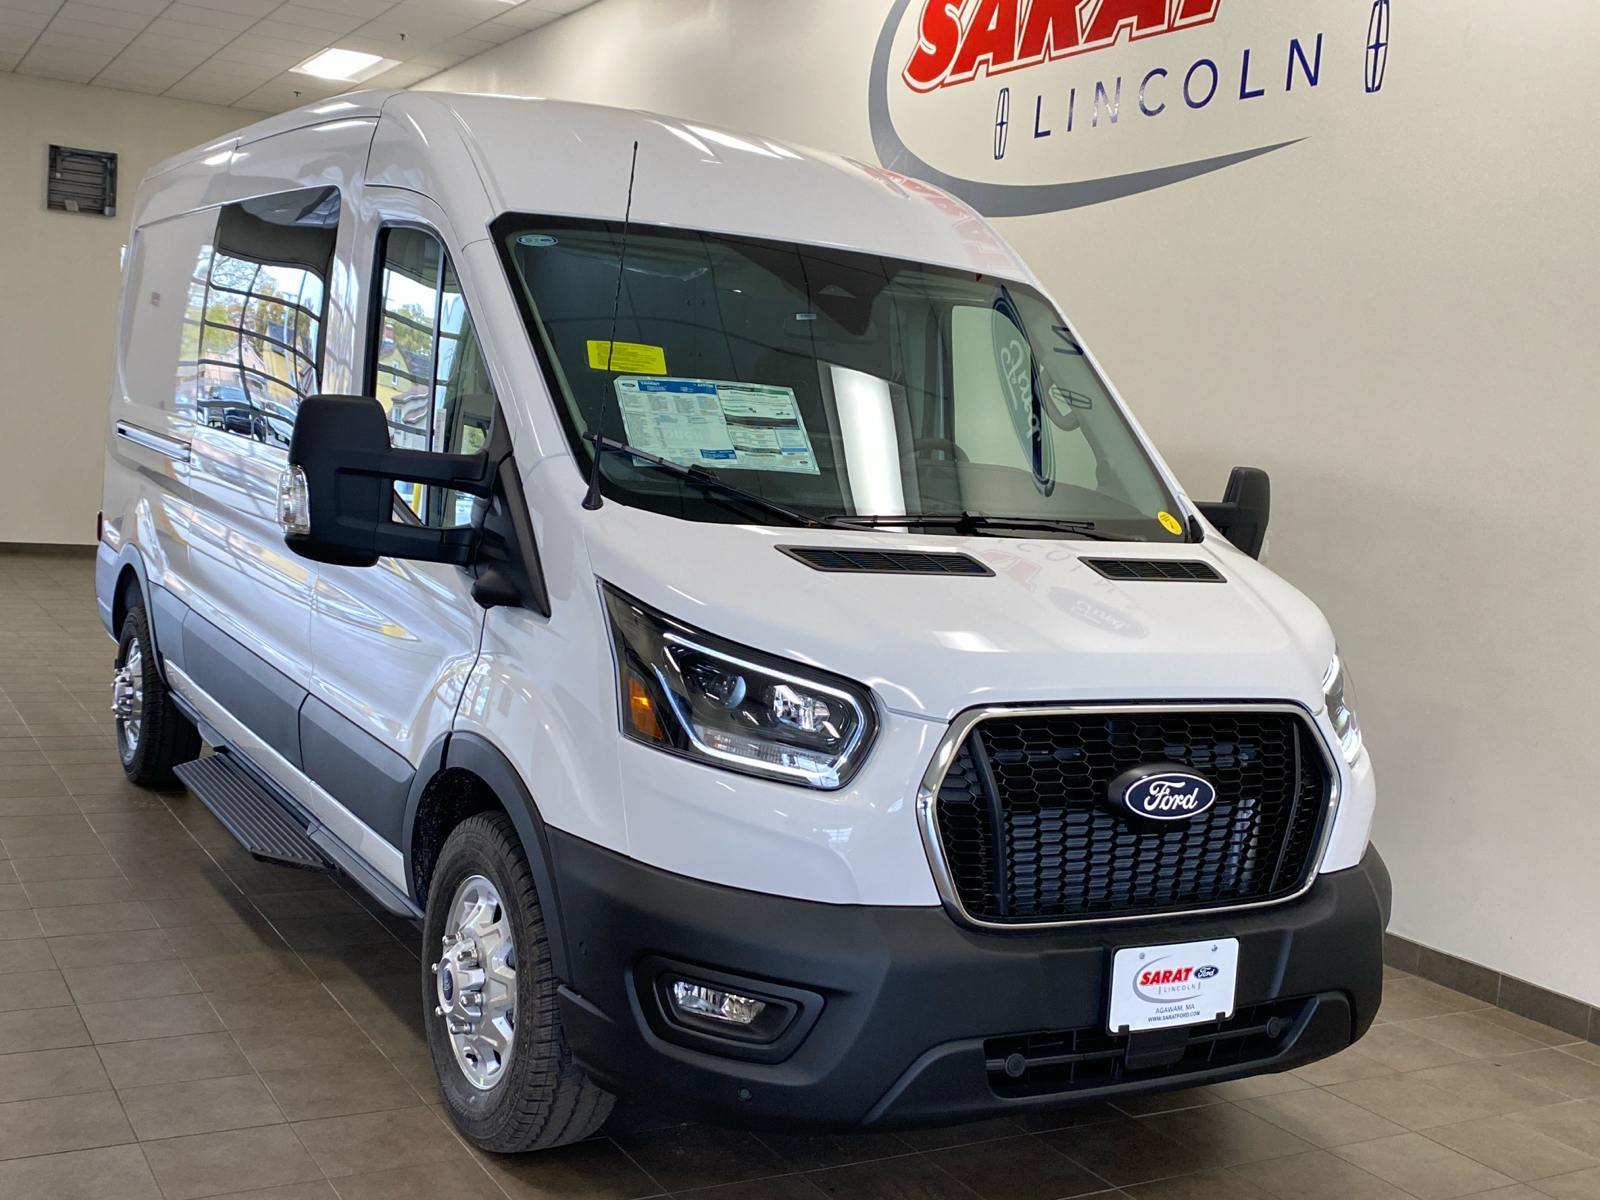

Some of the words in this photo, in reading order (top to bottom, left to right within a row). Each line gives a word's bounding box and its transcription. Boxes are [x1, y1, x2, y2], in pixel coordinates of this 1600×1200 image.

[1033, 33, 1323, 139] LINCOLN
[1143, 780, 1199, 811] Ford
[1139, 966, 1194, 987] SARAT
[1163, 983, 1196, 993] LINCOLN
[1147, 1010, 1201, 1023] WWW.SARATFORD.COM
[1155, 1004, 1184, 1014] AGAWAM,
